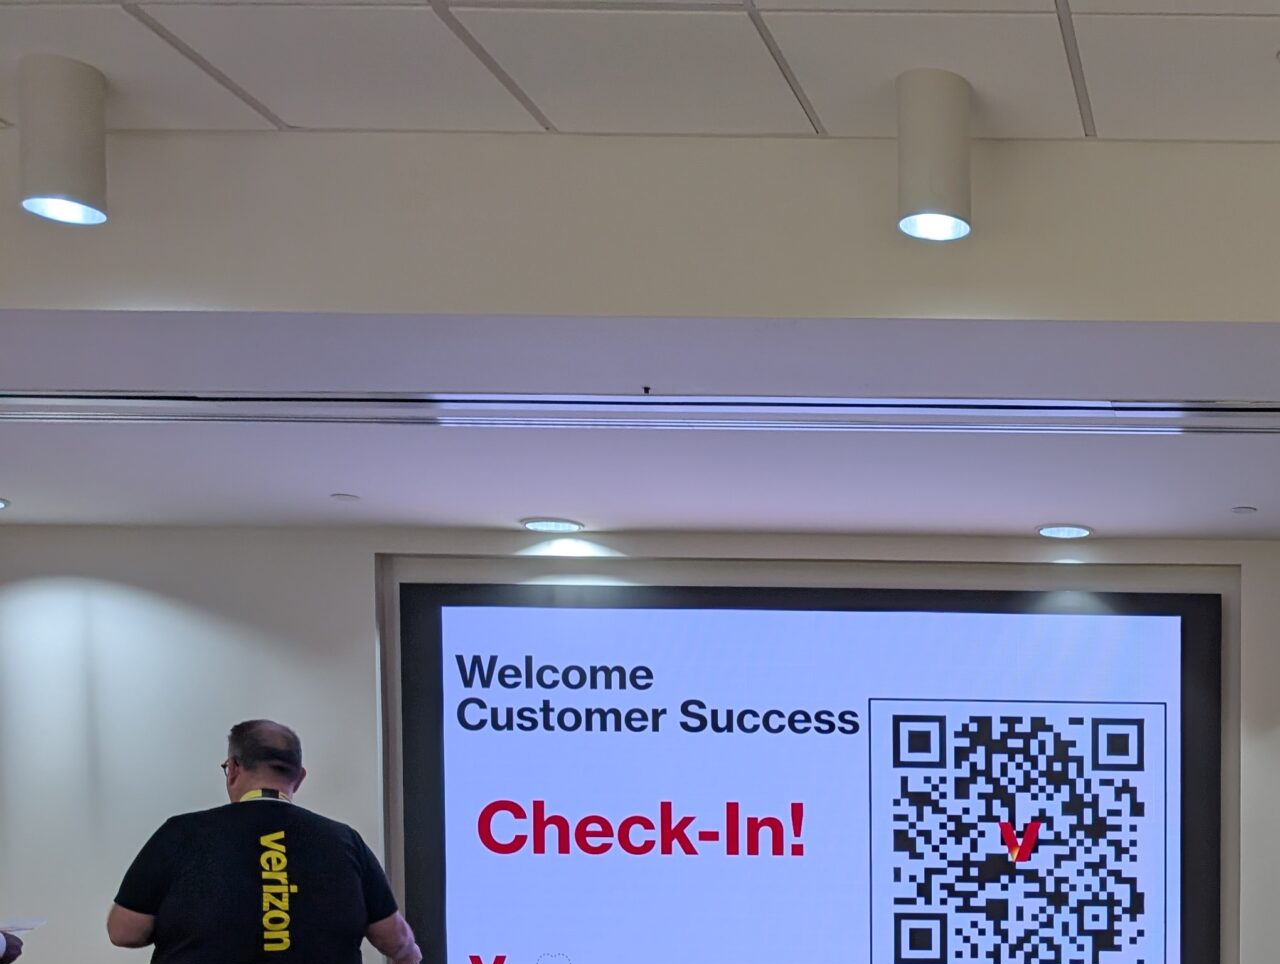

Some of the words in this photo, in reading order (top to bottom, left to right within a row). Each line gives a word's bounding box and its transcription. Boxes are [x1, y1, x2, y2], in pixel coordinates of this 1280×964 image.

[455, 654, 654, 690] Welcome
[456, 697, 667, 733] Customer
[679, 699, 860, 735] Success
[477, 800, 805, 856] Check-In!
[259, 830, 298, 952] verizon
